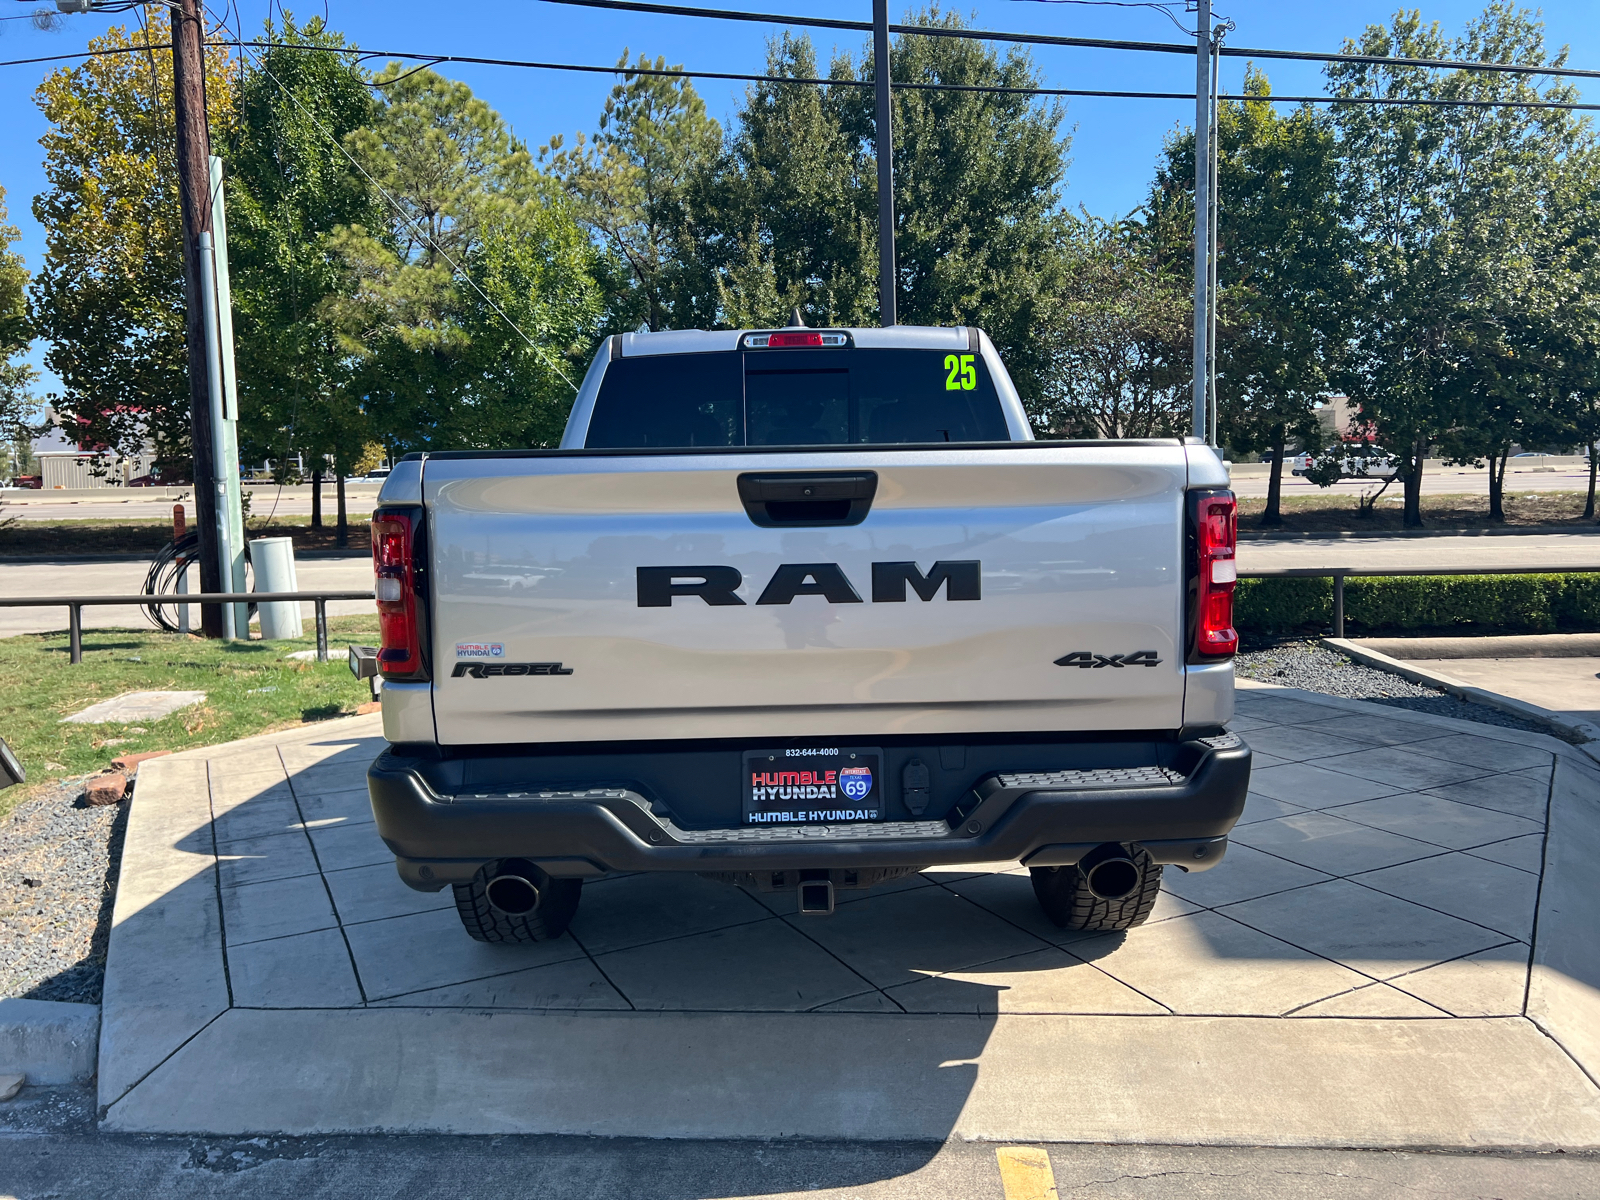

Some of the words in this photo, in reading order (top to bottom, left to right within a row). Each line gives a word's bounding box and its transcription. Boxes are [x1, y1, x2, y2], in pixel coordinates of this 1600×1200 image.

[944, 354, 976, 390] 25
[637, 560, 981, 607] RAM
[451, 662, 574, 679] REBEL
[785, 748, 839, 757] 832-644-4000
[752, 771, 836, 786] HUMBLE
[752, 785, 836, 800] HYUNDAI
[845, 781, 867, 796] 69
[749, 811, 806, 822] HUMBLE
[809, 810, 868, 820] HYUNDAI
